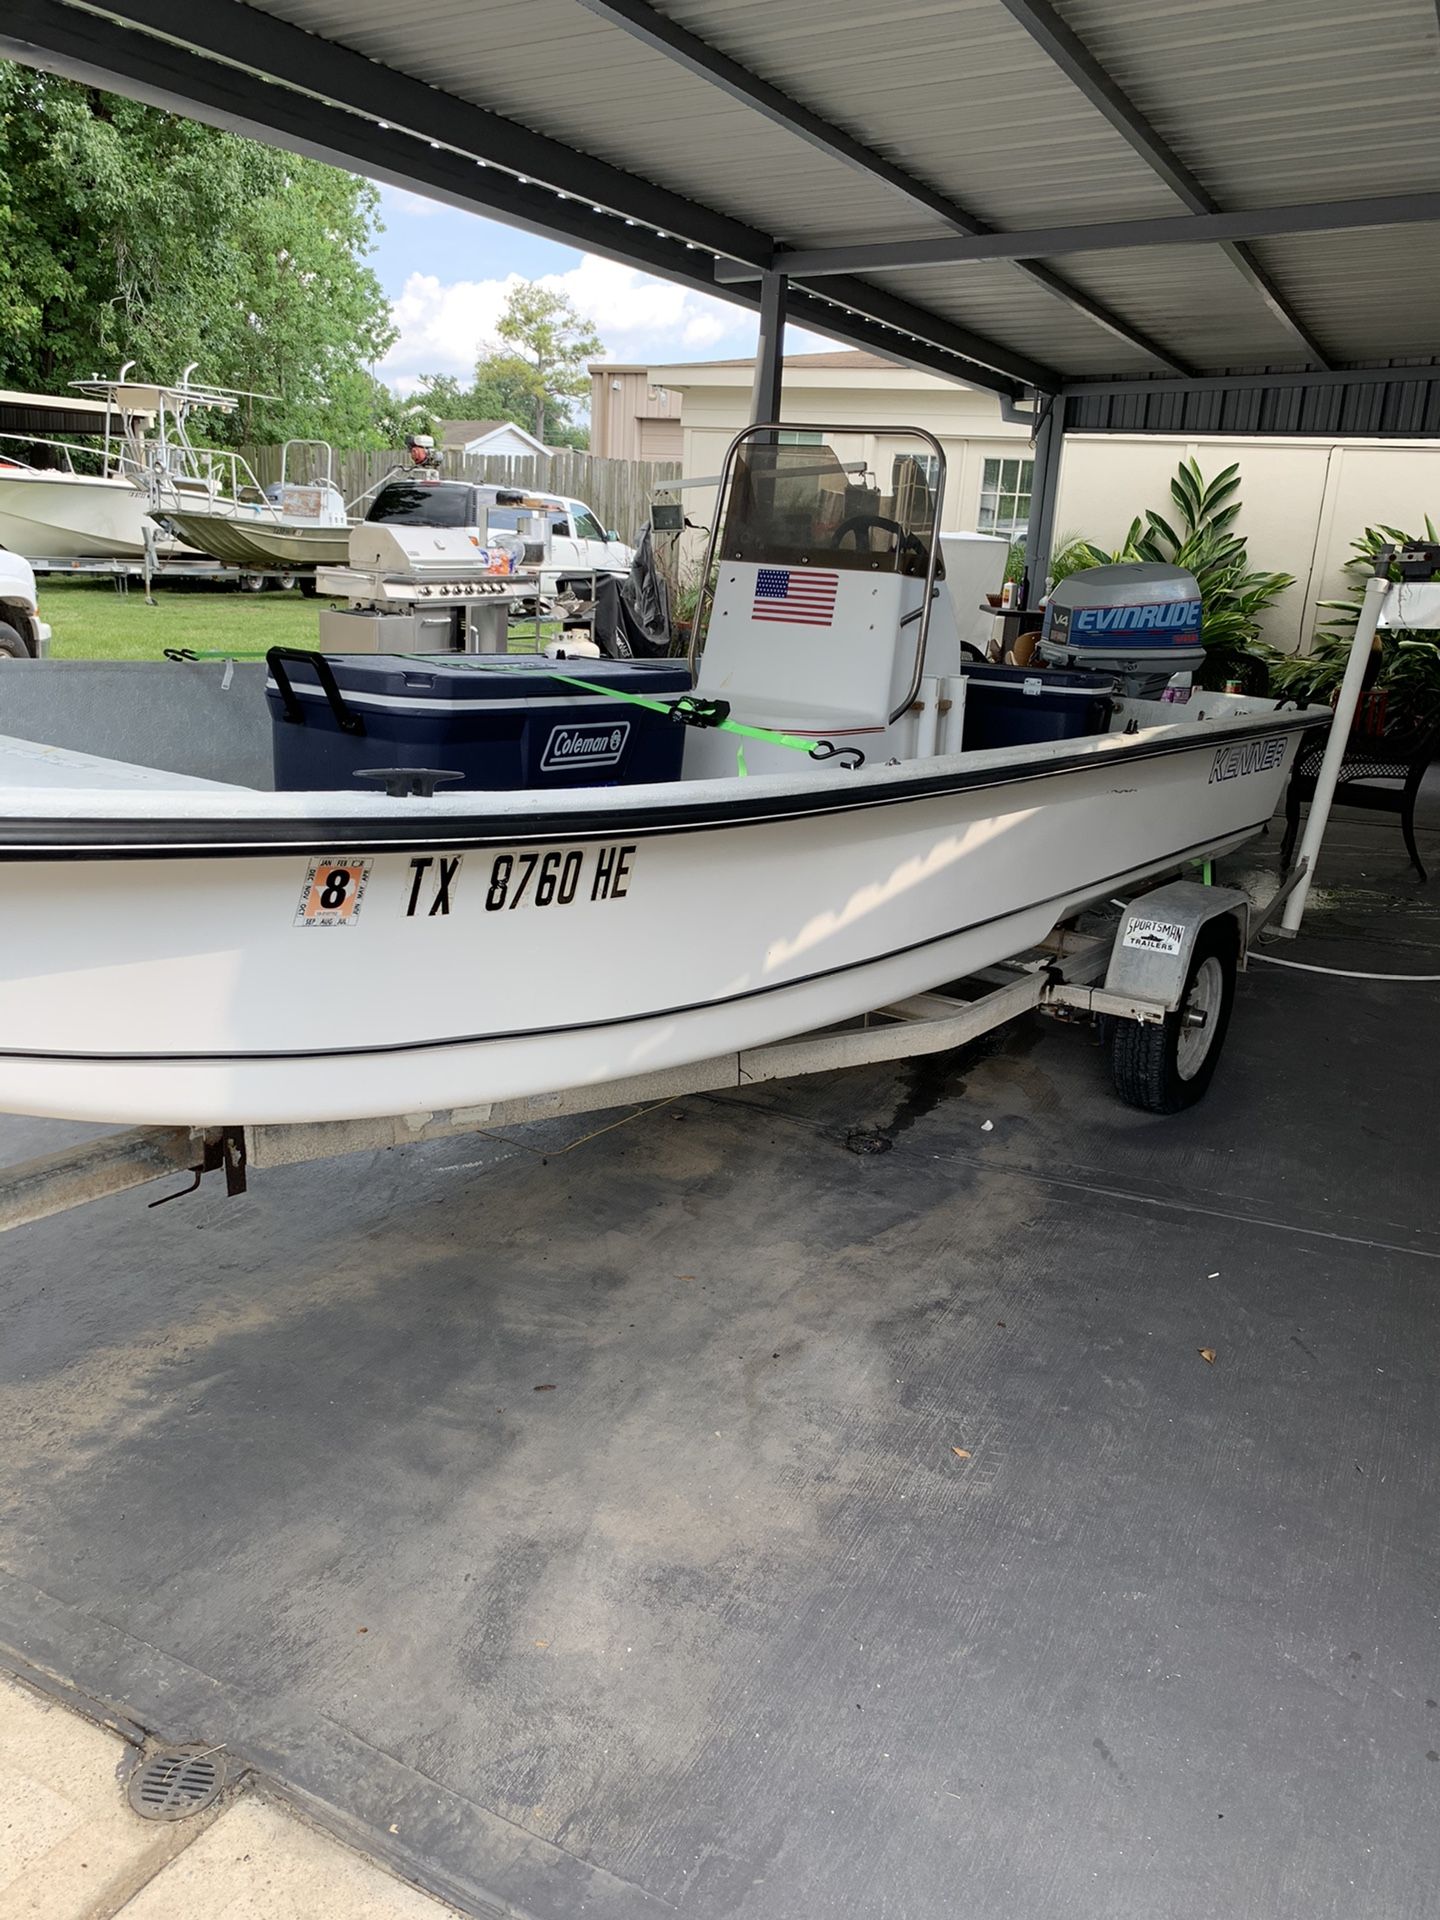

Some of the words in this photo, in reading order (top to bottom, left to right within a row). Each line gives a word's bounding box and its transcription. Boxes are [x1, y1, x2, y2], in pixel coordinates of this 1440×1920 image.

[1053, 612, 1068, 627] V4
[1078, 602, 1200, 630] EVINRUDE
[554, 731, 609, 756] Coleman
[1208, 737, 1288, 784] KENNER
[320, 869, 350, 909] 8
[406, 855, 463, 916] TX
[485, 851, 583, 911] 8760
[590, 845, 637, 901] HE
[305, 918, 316, 926] SEP
[320, 918, 333, 926] AUG
[1127, 918, 1184, 944] SPORTSMAN
[1130, 937, 1173, 951] TRAILERS
